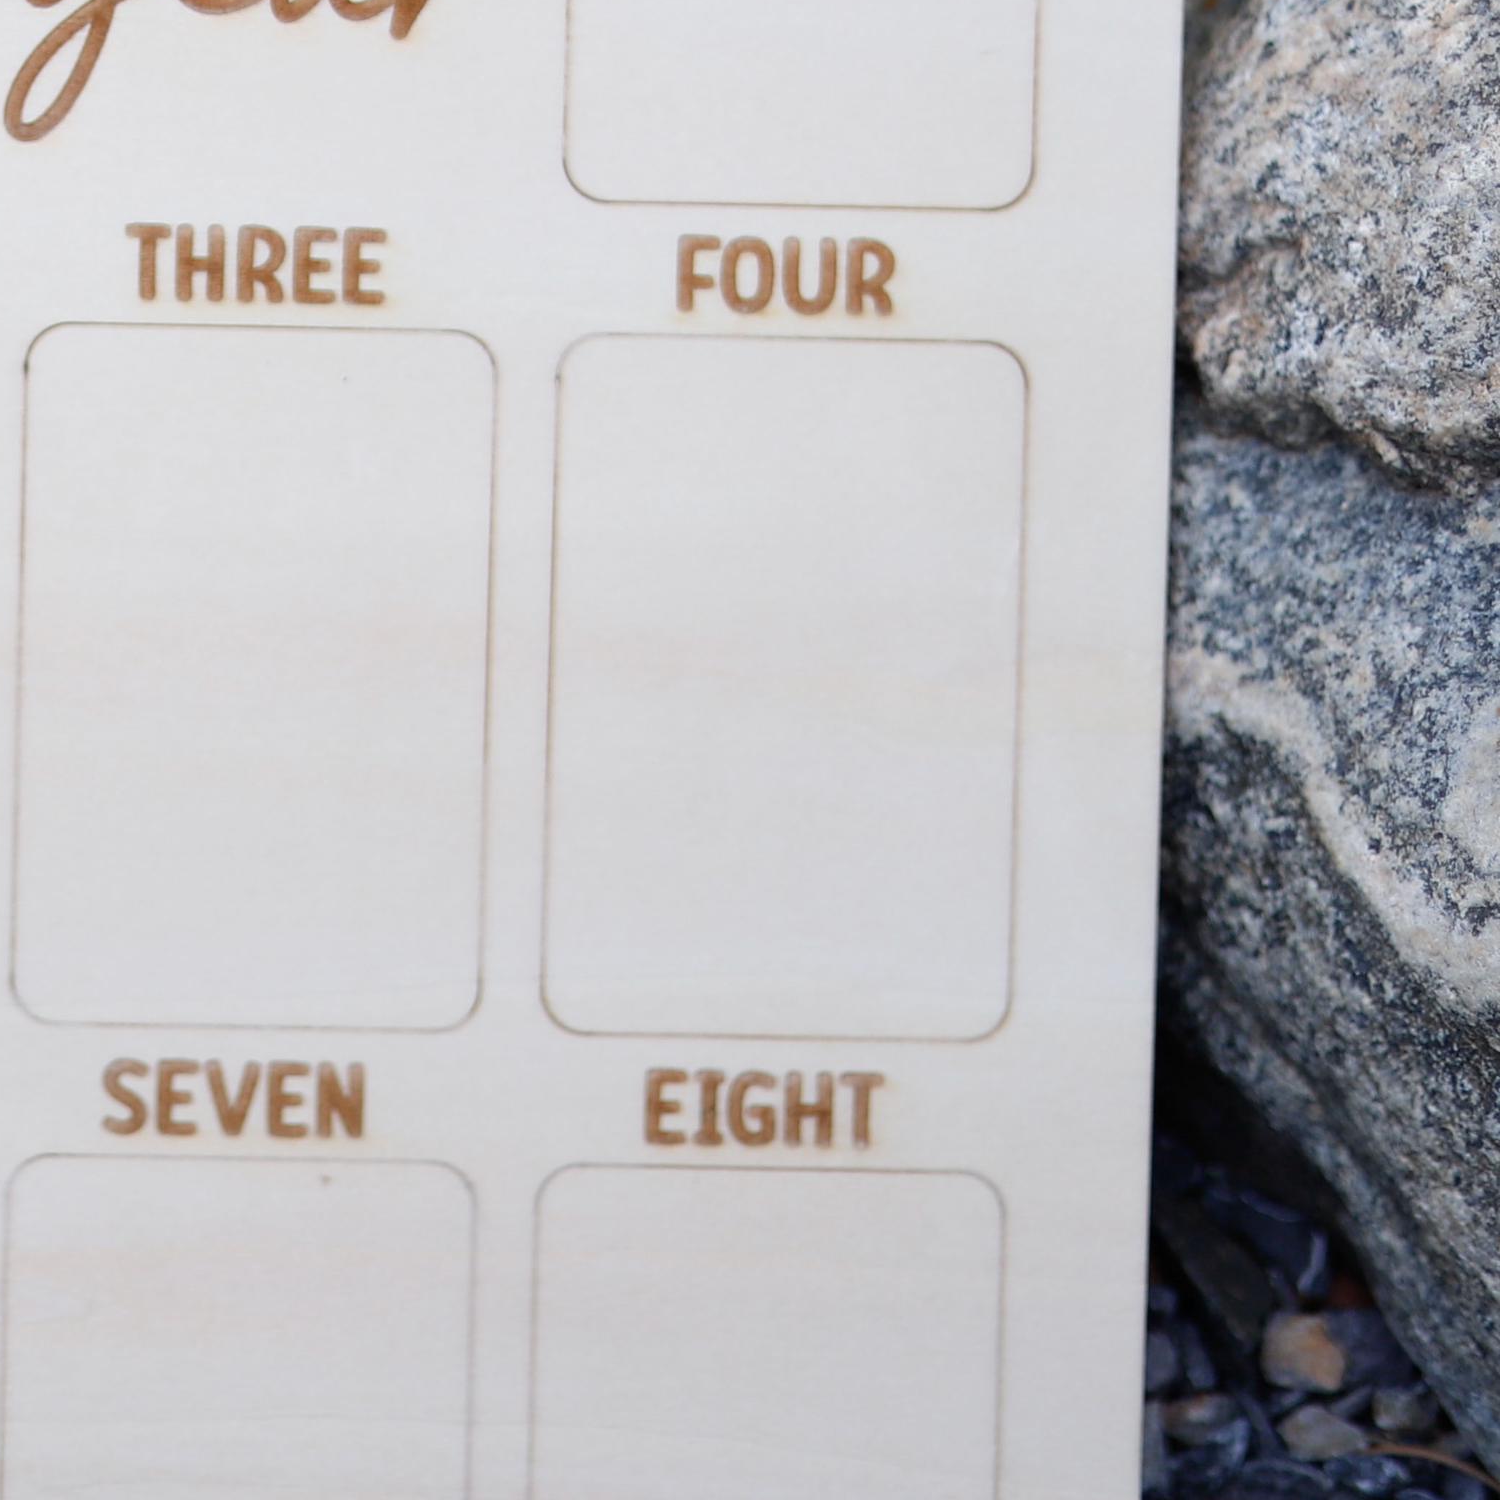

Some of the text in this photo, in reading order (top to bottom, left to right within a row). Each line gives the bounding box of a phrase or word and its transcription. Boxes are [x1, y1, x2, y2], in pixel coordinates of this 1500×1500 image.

[127, 222, 387, 307] THREE
[677, 234, 898, 316] FOUR
[103, 1057, 365, 1141] SEVEN
[645, 1070, 889, 1149] EIGHT
